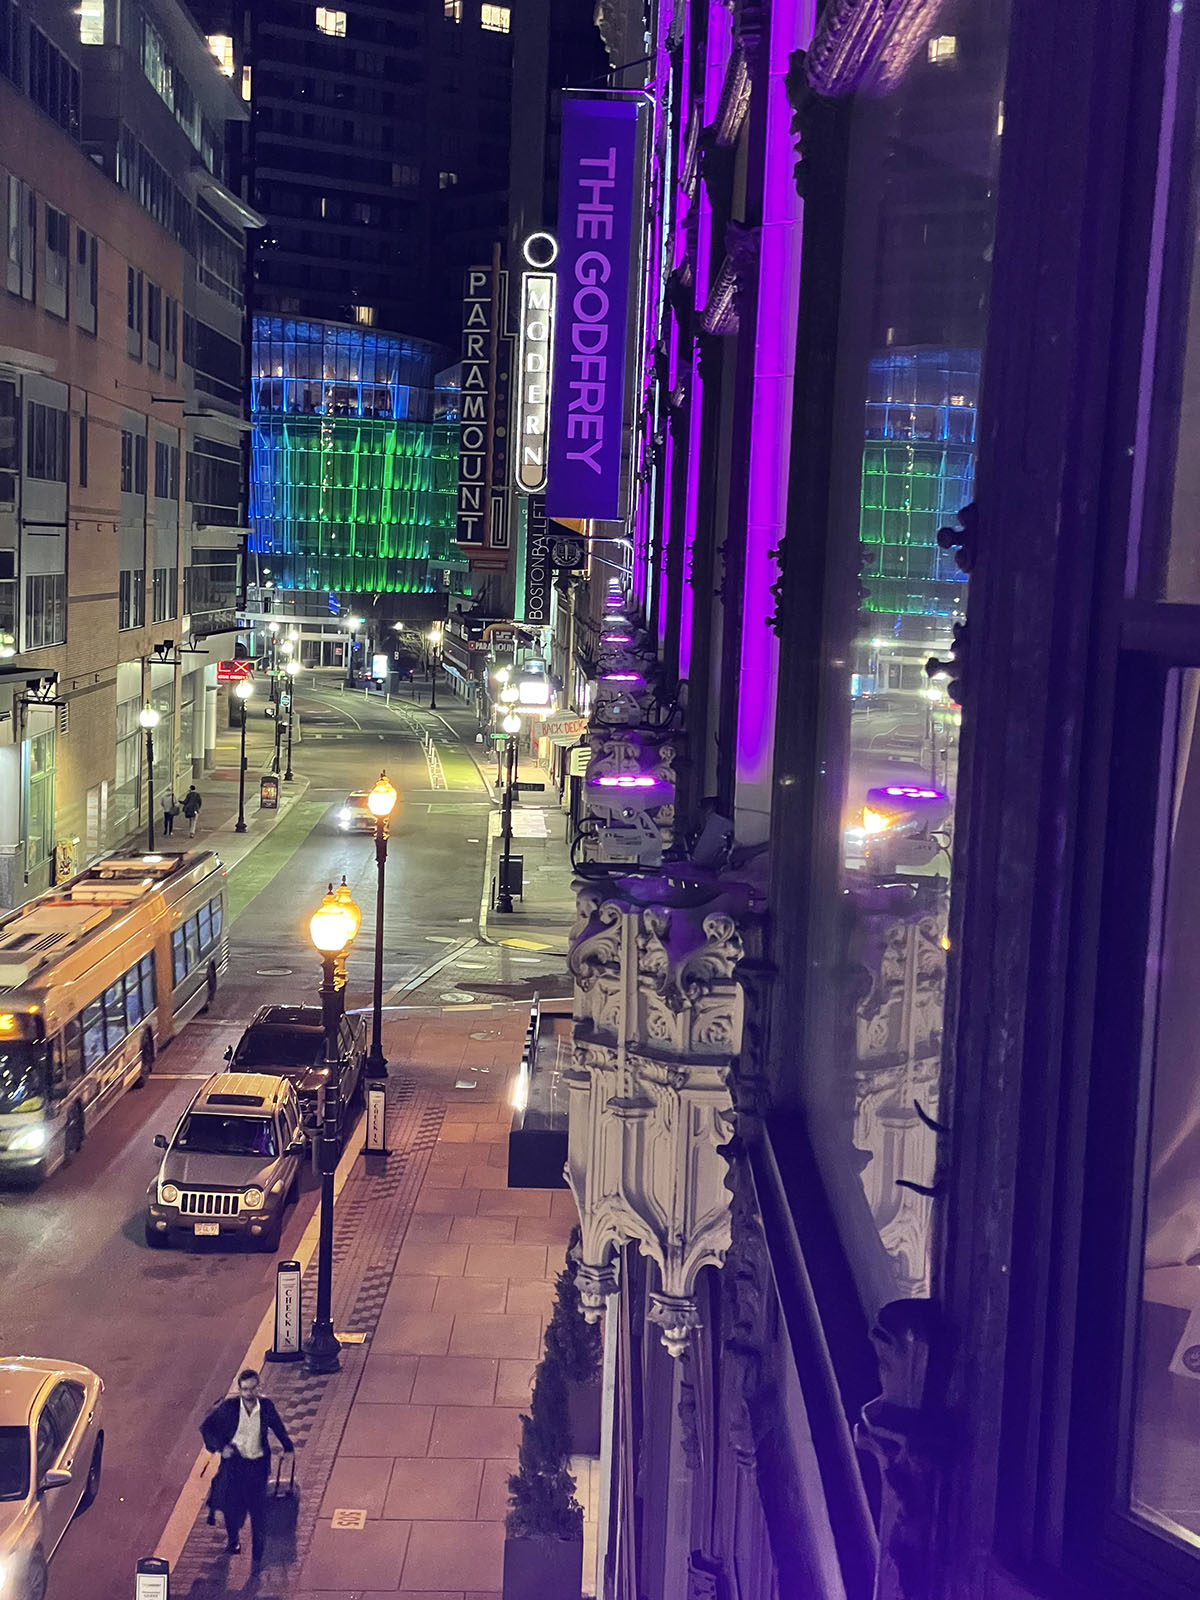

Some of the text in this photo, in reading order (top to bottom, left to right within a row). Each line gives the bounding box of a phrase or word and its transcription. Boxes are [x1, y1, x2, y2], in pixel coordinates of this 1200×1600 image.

[524, 290, 549, 466] MODERN
[566, 147, 617, 475] THE GODFREY
[461, 272, 487, 540] PARAMOUNT
[541, 722, 562, 736] BACK
[284, 1330, 292, 1345] IN
